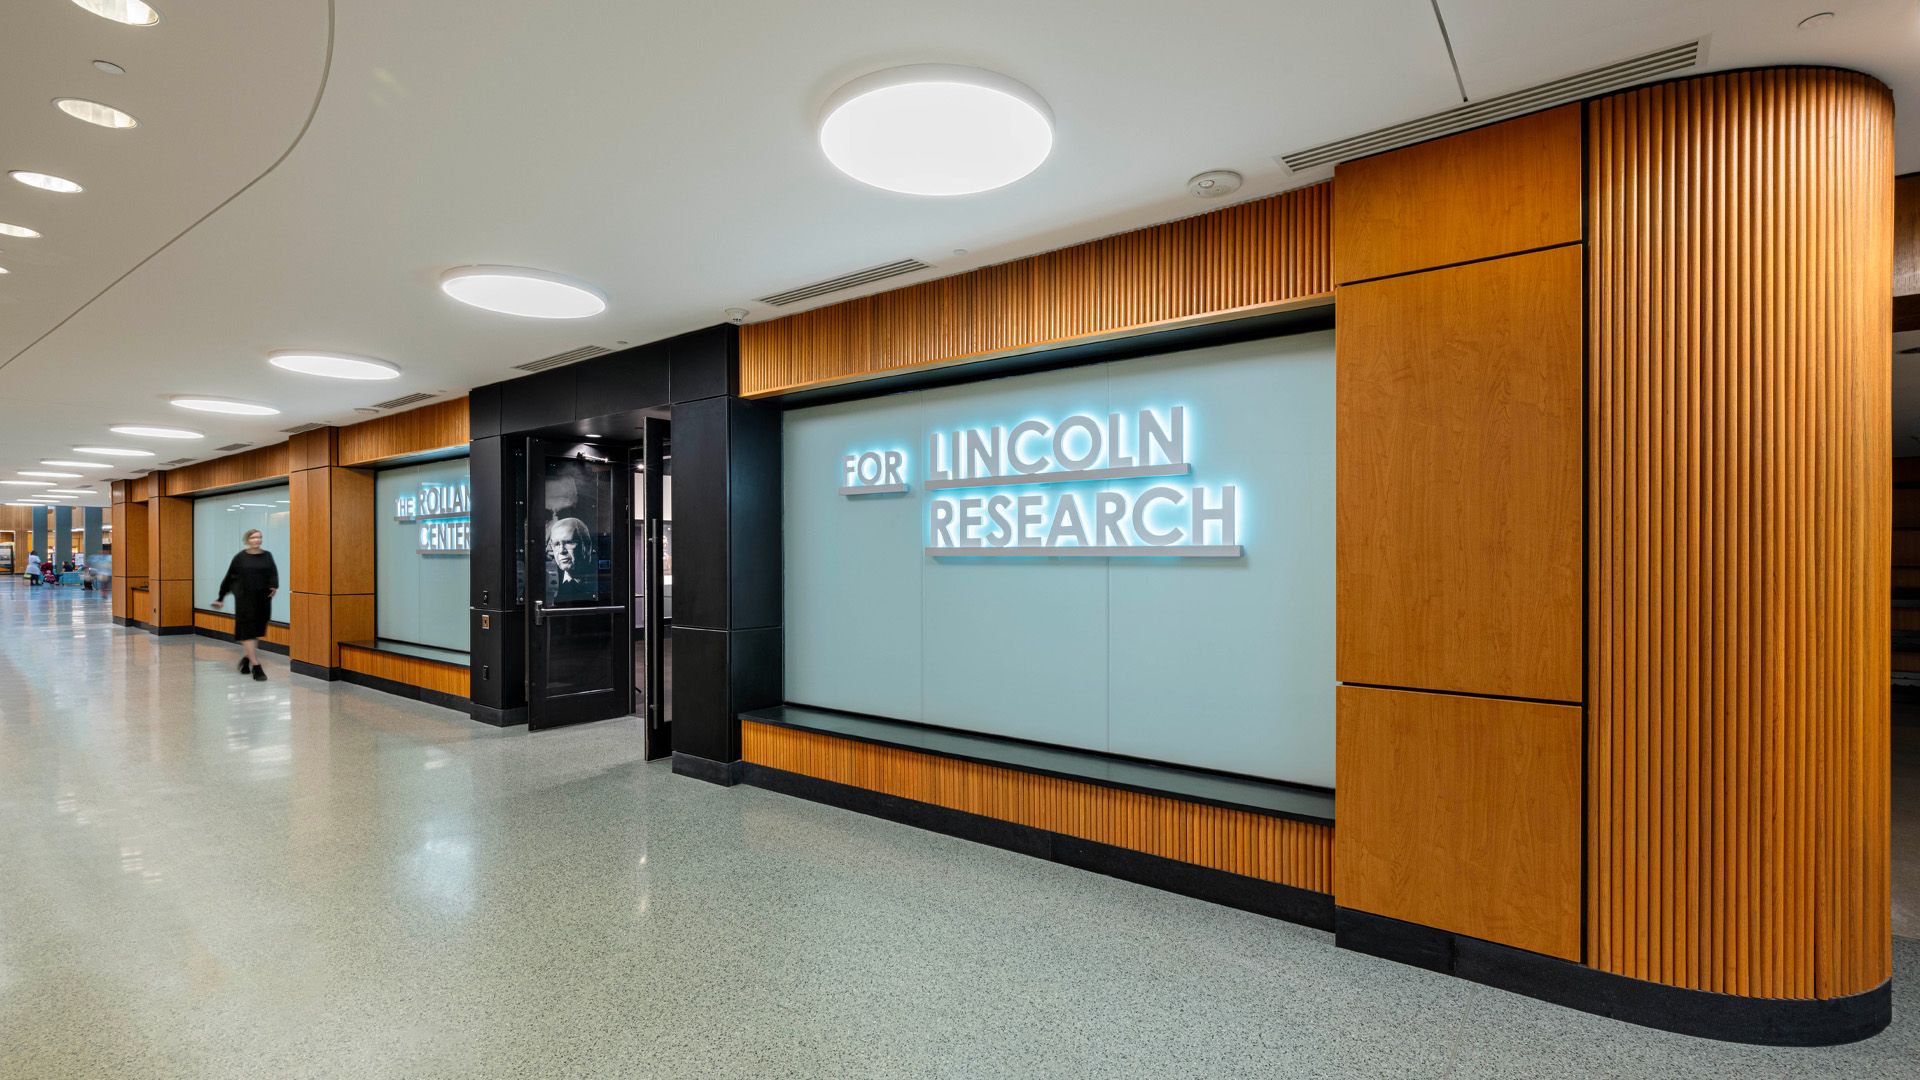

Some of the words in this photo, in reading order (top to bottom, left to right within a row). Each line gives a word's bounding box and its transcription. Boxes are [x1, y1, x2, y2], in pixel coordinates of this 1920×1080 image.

[842, 451, 904, 486] FOR
[930, 406, 1184, 480] LINCOLN
[395, 497, 415, 517] THE
[930, 485, 1236, 548] RESEARCH
[419, 522, 470, 550] CENTER
